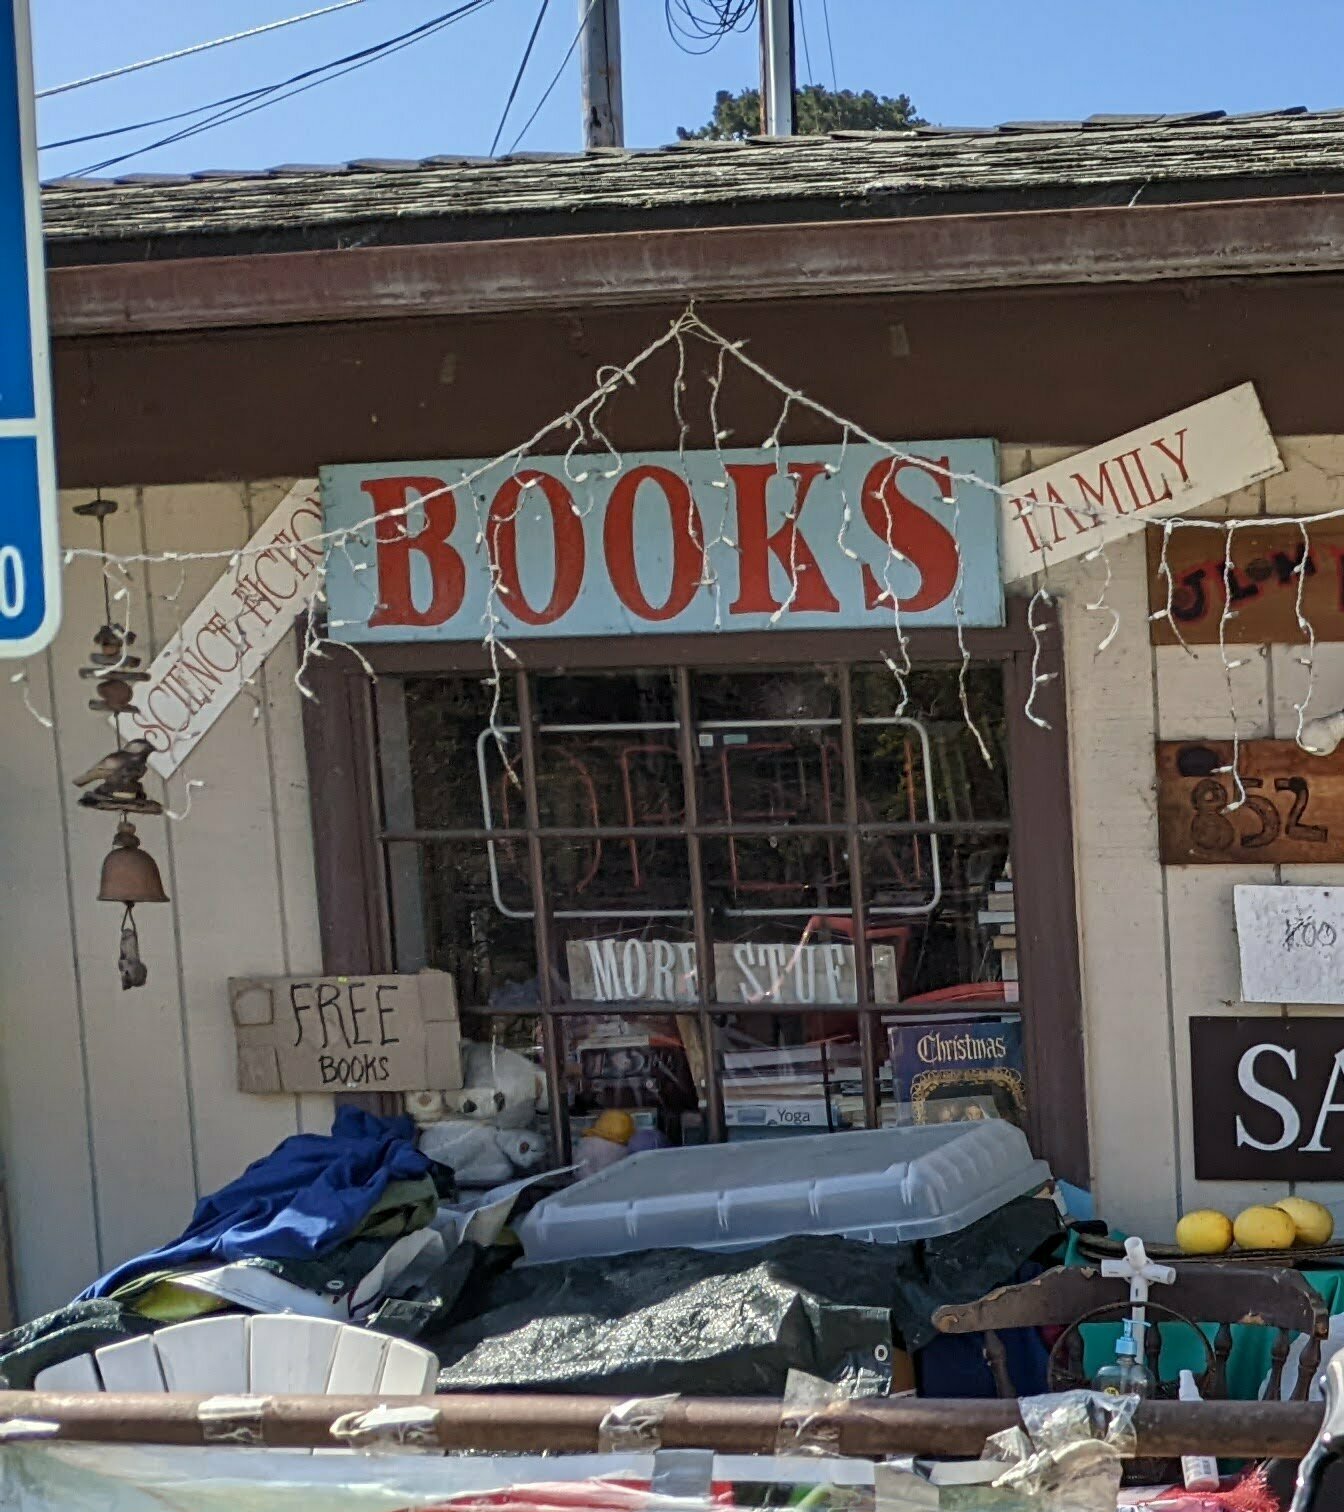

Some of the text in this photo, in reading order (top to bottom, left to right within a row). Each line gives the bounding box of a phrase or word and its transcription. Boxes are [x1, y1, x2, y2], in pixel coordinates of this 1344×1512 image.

[1008, 428, 1188, 553] FAMILY
[361, 456, 959, 628] BOOKS
[133, 486, 323, 754] SCIENCE FICTIO
[1190, 777, 1328, 850] 852
[586, 938, 857, 1003] MORE STUF
[287, 982, 400, 1049] FREE
[916, 1032, 1007, 1064] Christmas
[318, 1054, 390, 1086] BOOKS
[775, 1107, 811, 1126] Yoga
